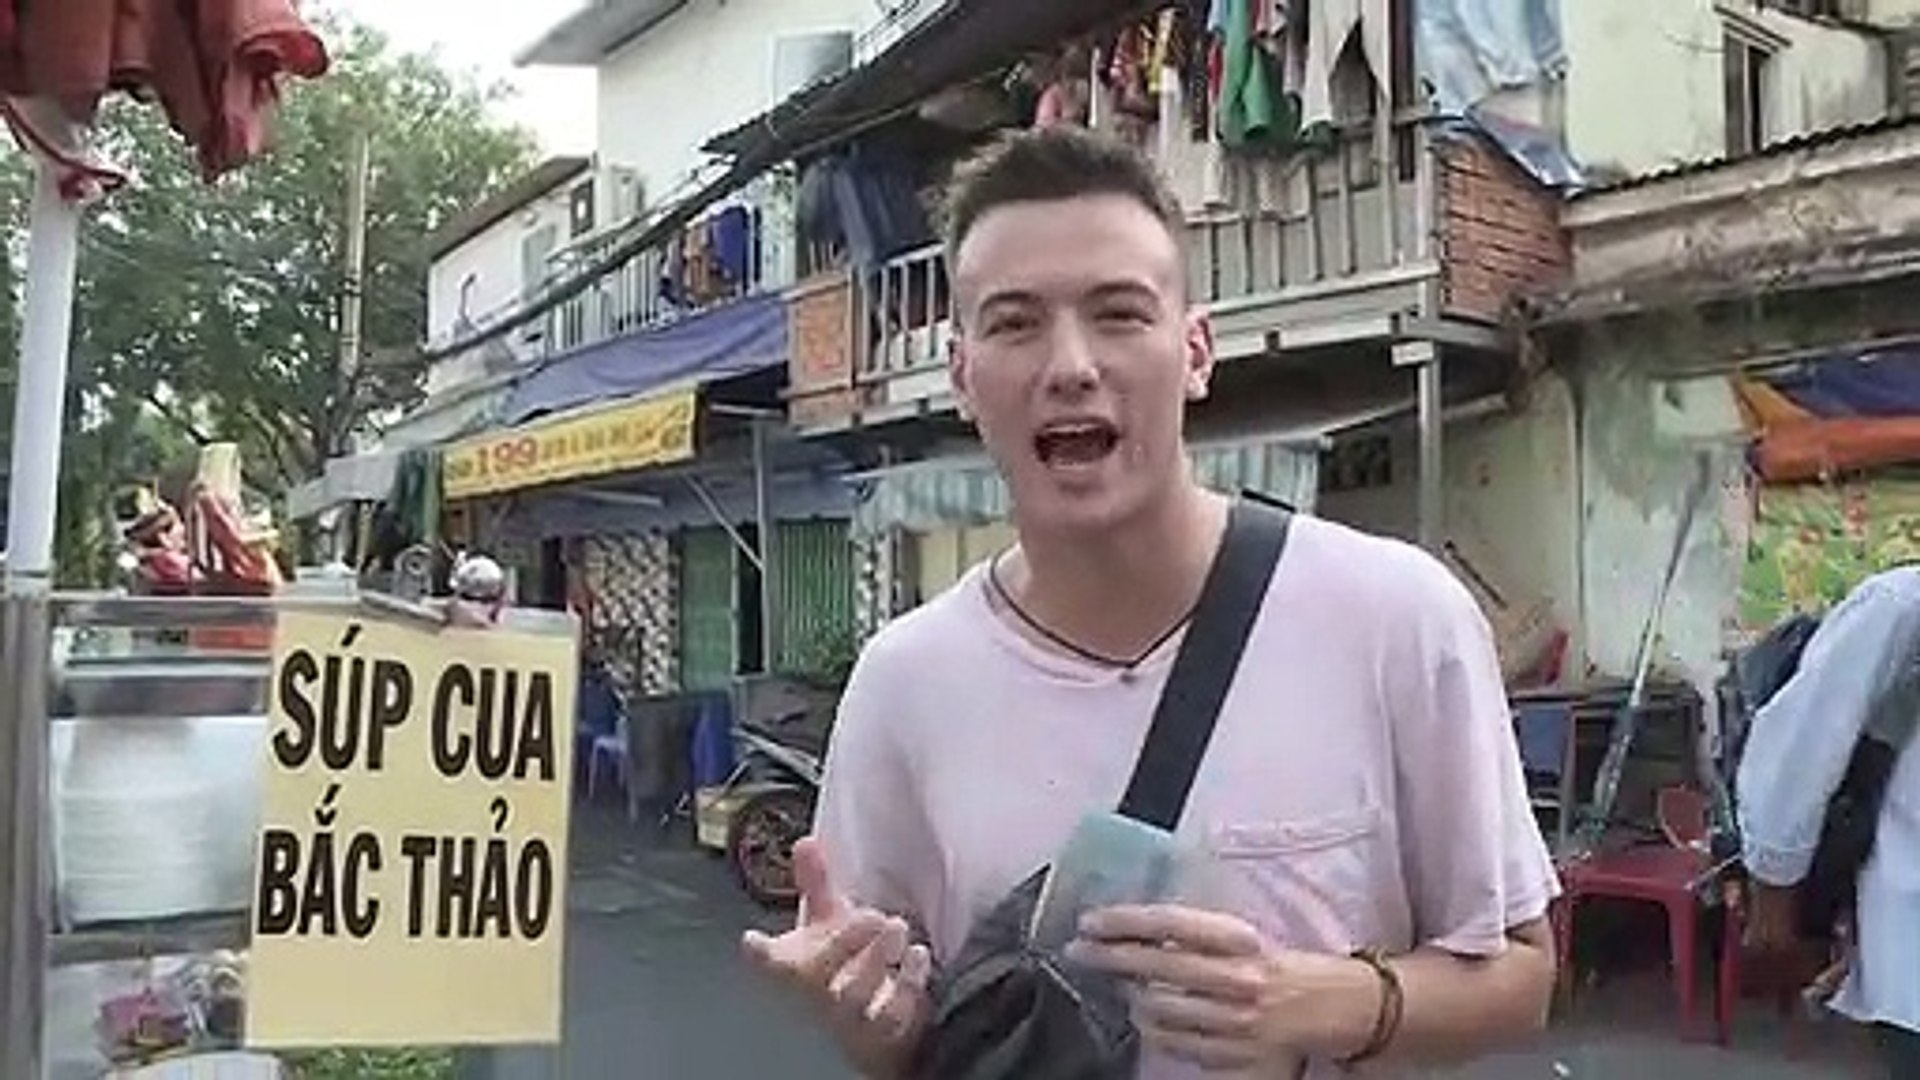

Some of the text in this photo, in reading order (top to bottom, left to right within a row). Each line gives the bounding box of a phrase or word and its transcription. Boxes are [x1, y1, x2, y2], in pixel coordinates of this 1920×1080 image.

[476, 436, 538, 476] 199
[273, 624, 555, 781] SÚP CUA
[257, 783, 553, 940] BẮC THẢO
